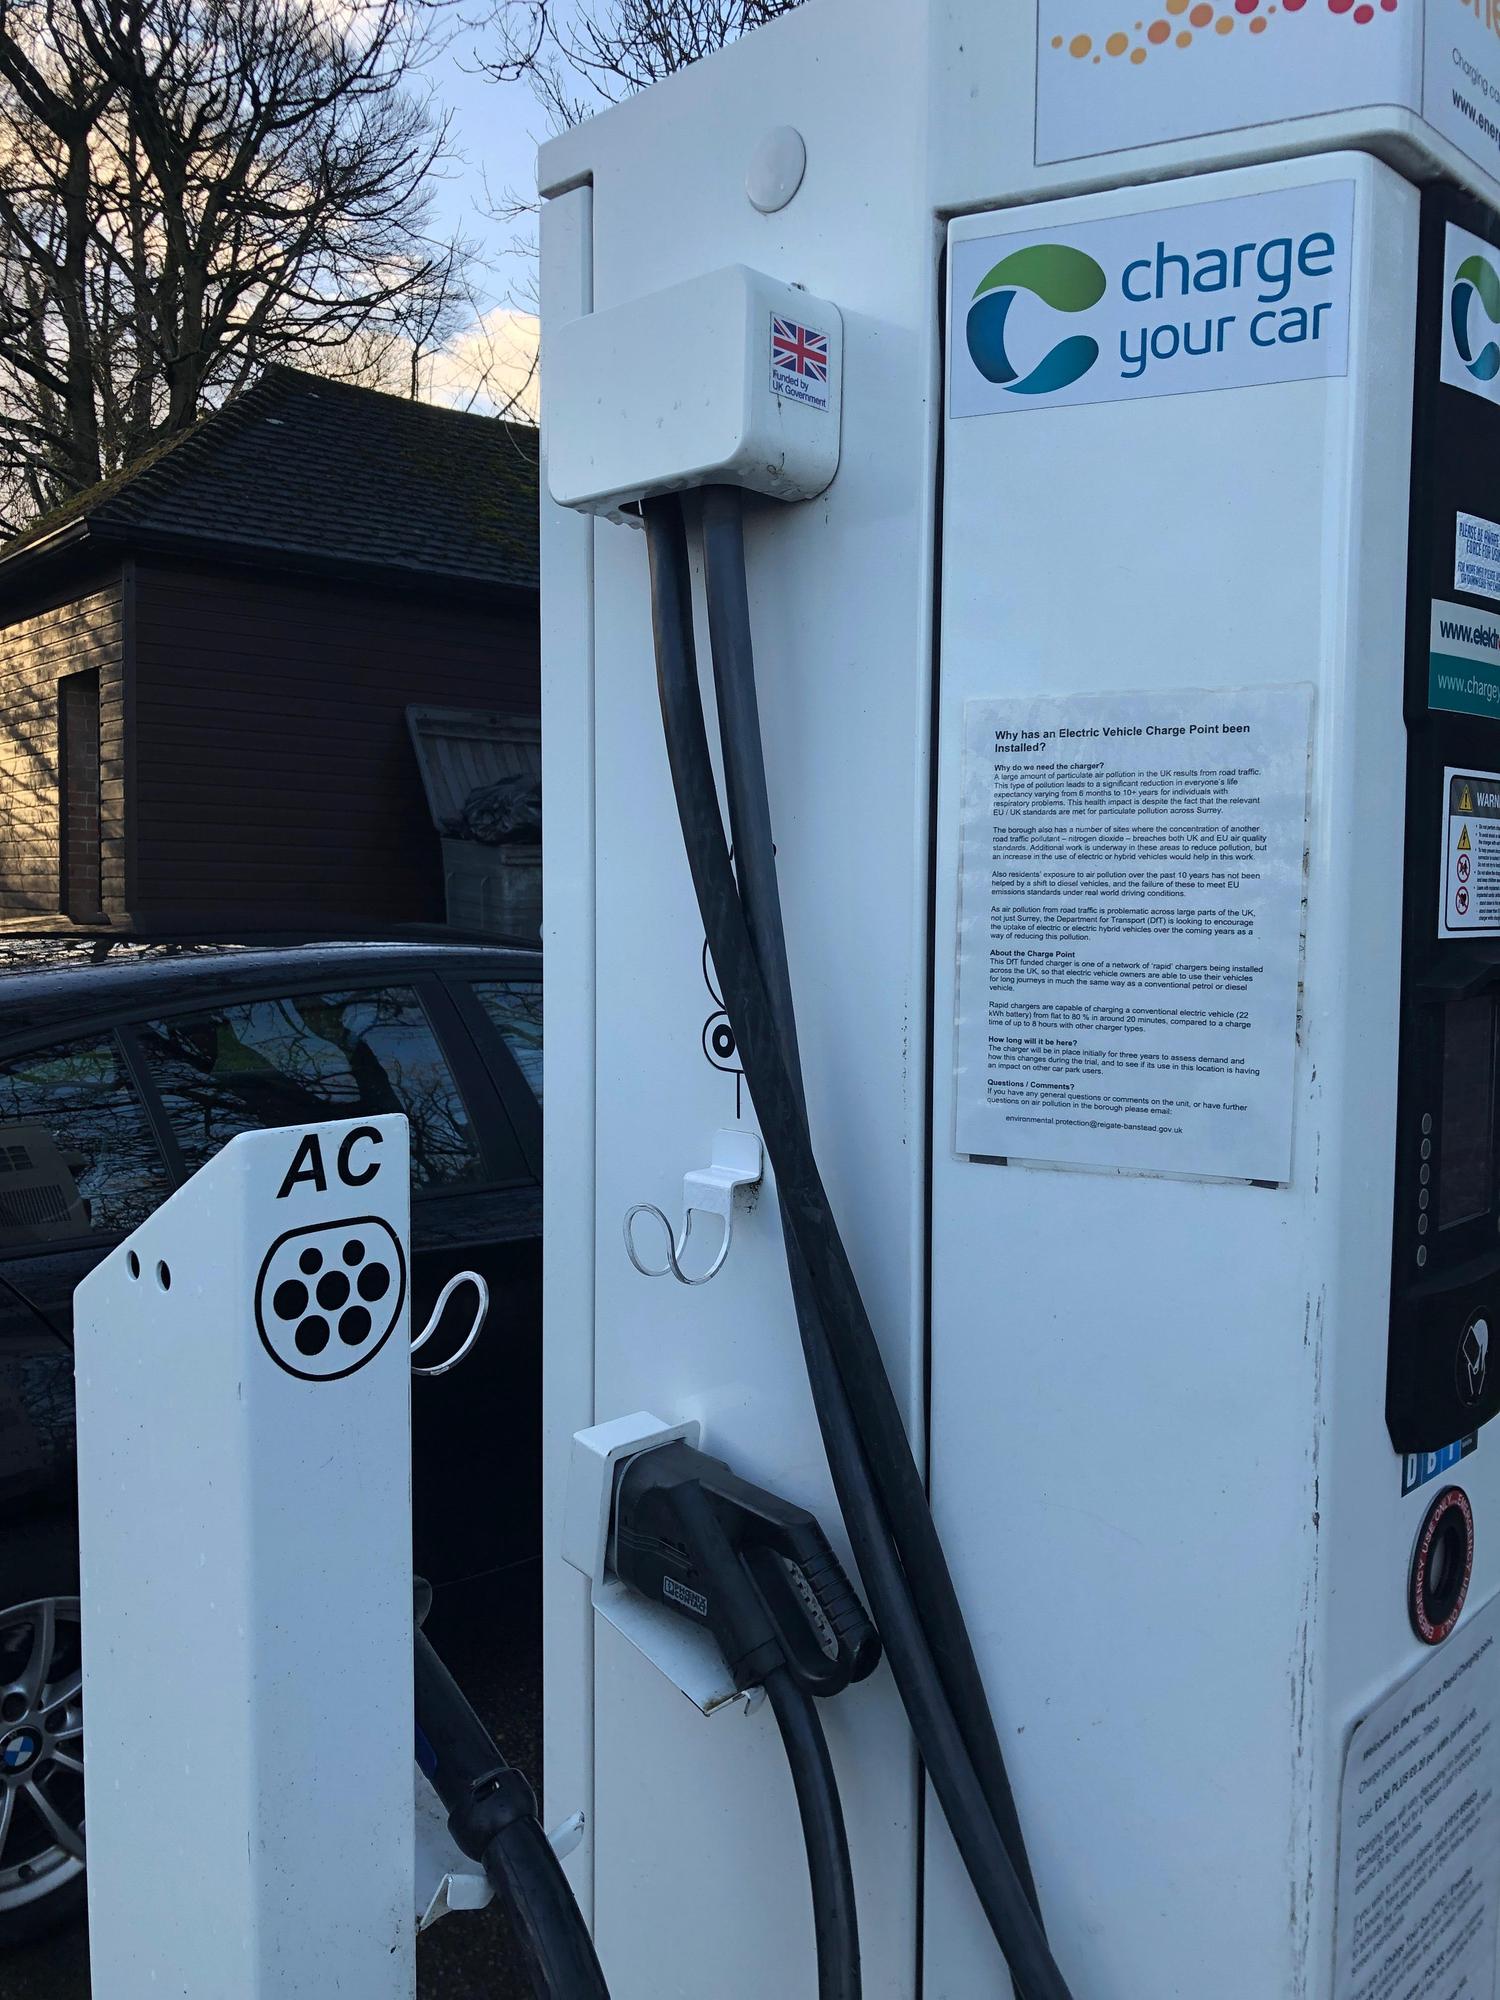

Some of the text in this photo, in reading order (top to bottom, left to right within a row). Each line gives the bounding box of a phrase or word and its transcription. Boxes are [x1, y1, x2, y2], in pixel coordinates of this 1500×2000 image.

[1452, 48, 1488, 96] Charging
[1121, 232, 1335, 302] charge
[1120, 302, 1332, 378] your car
[773, 370, 808, 392] Funded by
[772, 381, 826, 407] UK Government
[1440, 620, 1500, 650] www.elektr
[995, 729, 1018, 741] Why
[1021, 728, 1040, 738] has
[1059, 727, 1100, 737] Electric
[1103, 726, 1143, 736] Vehicle
[1146, 724, 1186, 737] Charge
[1189, 724, 1218, 734] Point
[1221, 723, 1250, 733] been
[995, 741, 1046, 751] Installed?
[994, 764, 1010, 772] Why
[1070, 762, 1104, 771] charger?
[1001, 772, 1018, 781] large
[1056, 771, 1092, 780] particulate
[1105, 770, 1135, 779] pollution
[1012, 906, 1040, 914] pollution
[1107, 907, 1149, 916] problematic
[1176, 908, 1195, 916] large
[1197, 908, 1216, 917] parts
[1003, 915, 1015, 923] just
[1056, 916, 1097, 924] Department
[1110, 916, 1145, 925] Transport
[1176, 917, 1202, 926] looking
[1027, 950, 1053, 958] Charge
[1045, 959, 1072, 968] charger
[1175, 963, 1207, 972] chargers
[1209, 964, 1230, 972] being
[1231, 964, 1263, 972] installed
[1006, 1036, 1022, 1045] long
[997, 1062, 1020, 1072] impact
[1032, 1064, 1050, 1072] other
[1064, 1066, 1080, 1075] park
[987, 1079, 1024, 1087] Questions
[1030, 1081, 1074, 1089] Comments?
[277, 1126, 384, 1199] AC
[1422, 1522, 1436, 1553] USE
